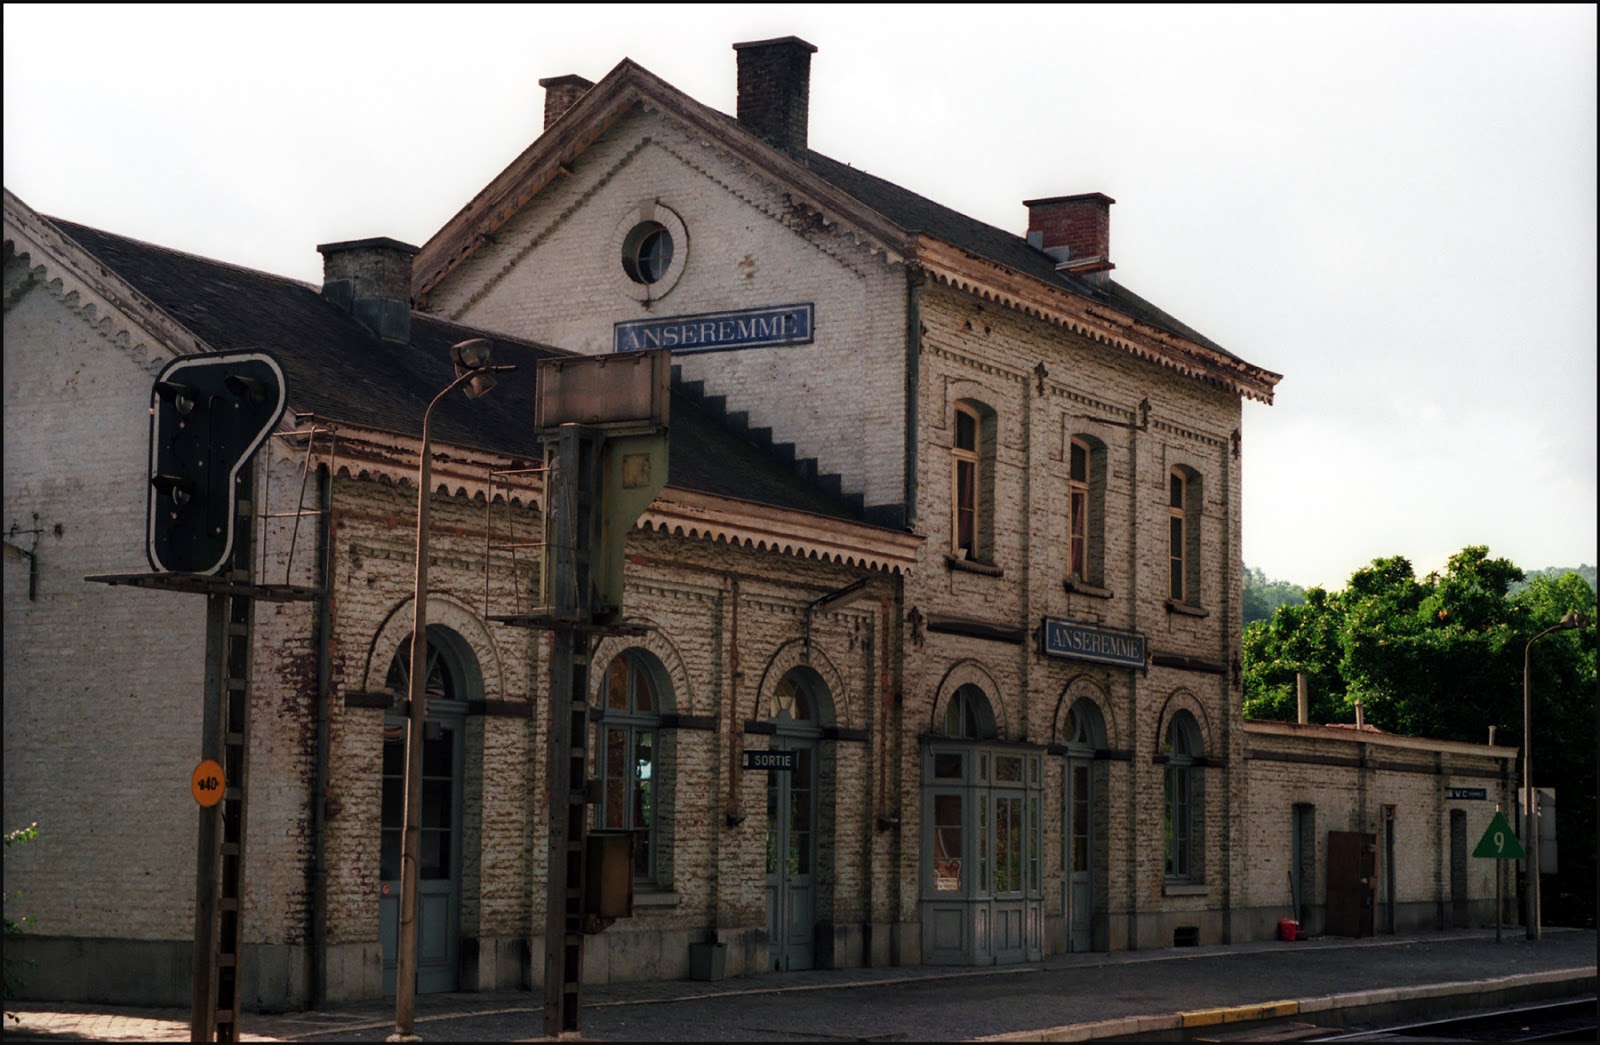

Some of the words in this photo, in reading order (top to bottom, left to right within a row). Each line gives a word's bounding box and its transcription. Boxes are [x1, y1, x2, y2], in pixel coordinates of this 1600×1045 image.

[625, 313, 798, 350] ANSEREMME
[1052, 628, 1140, 659] ANSEREMME
[754, 755, 792, 767] SORTIE
[1494, 831, 1505, 853] 9
